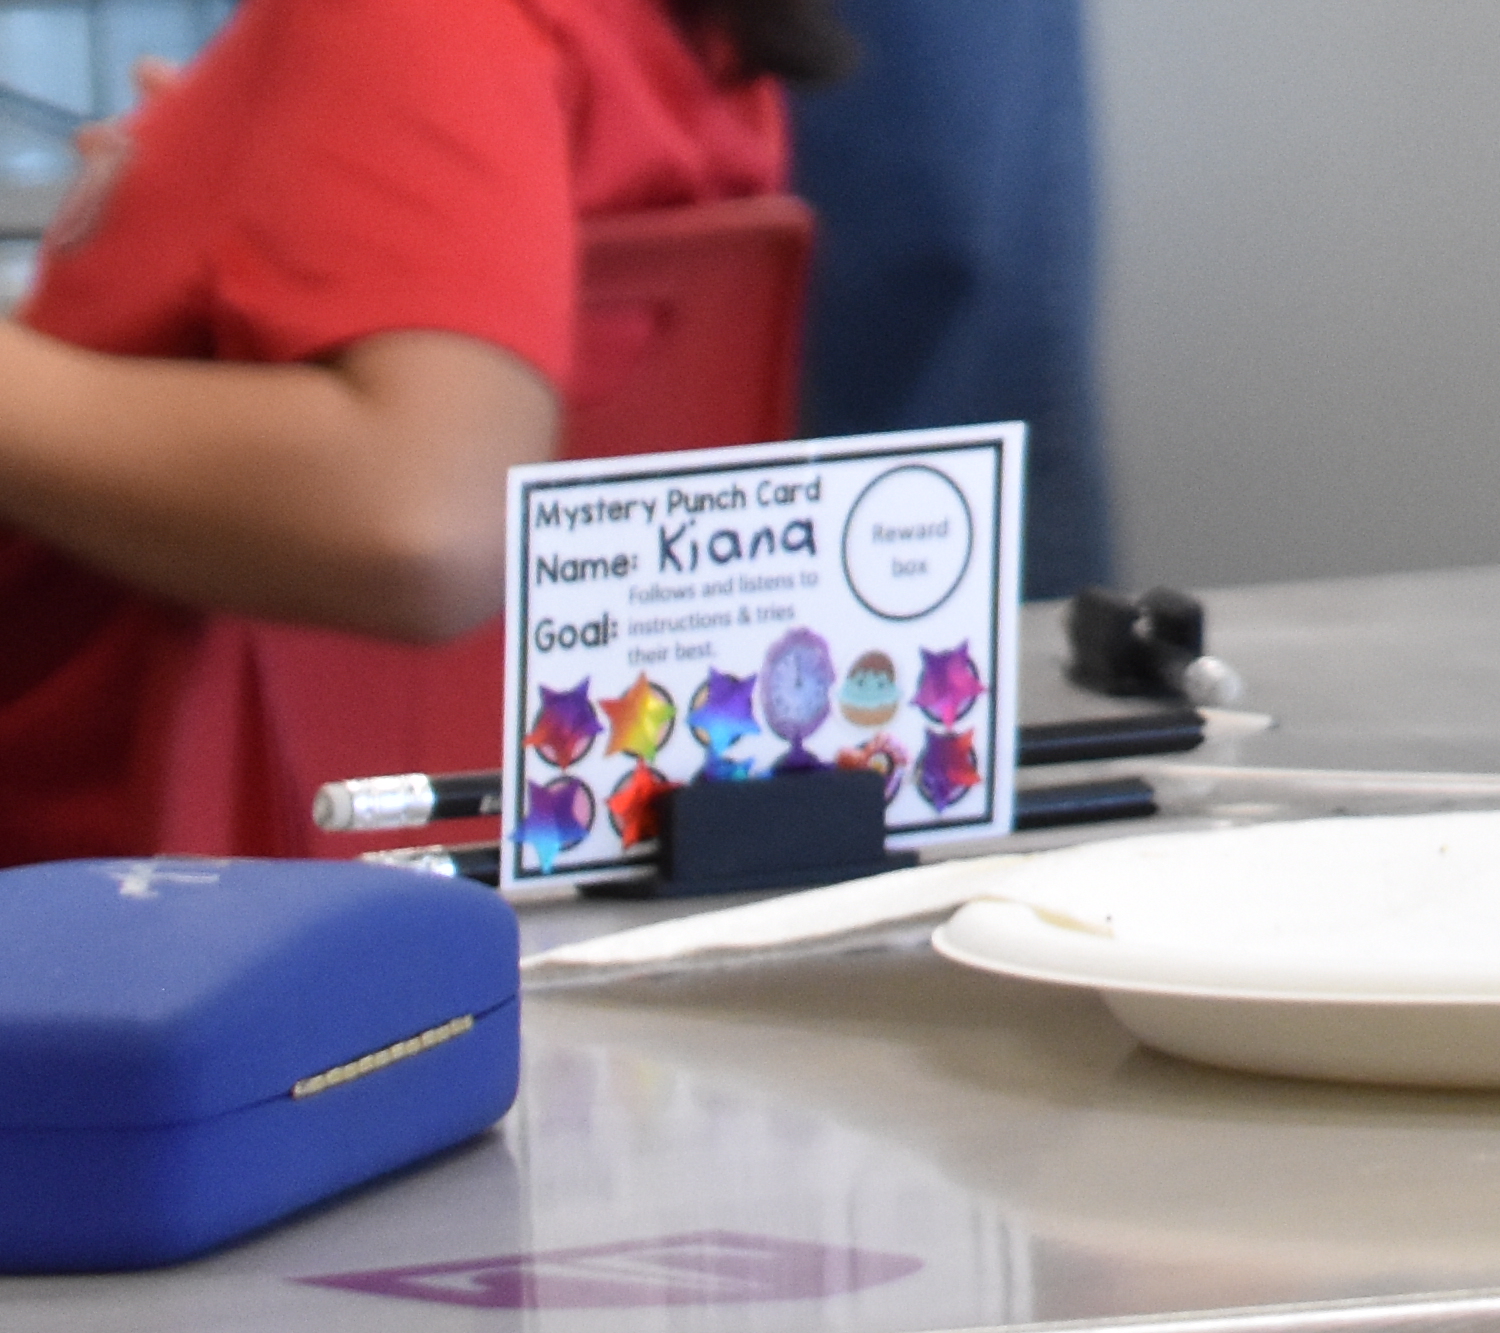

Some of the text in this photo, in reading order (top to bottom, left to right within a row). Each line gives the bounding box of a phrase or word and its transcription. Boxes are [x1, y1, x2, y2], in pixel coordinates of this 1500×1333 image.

[535, 475, 821, 531] Mystery Punch Card
[872, 516, 949, 543] Reward
[535, 518, 817, 585] Name: Kiana
[891, 556, 928, 578] box
[629, 570, 819, 605] Follows and listens to
[534, 611, 619, 653] Goal:
[628, 602, 795, 635] instructions & tries
[628, 644, 669, 666] their
